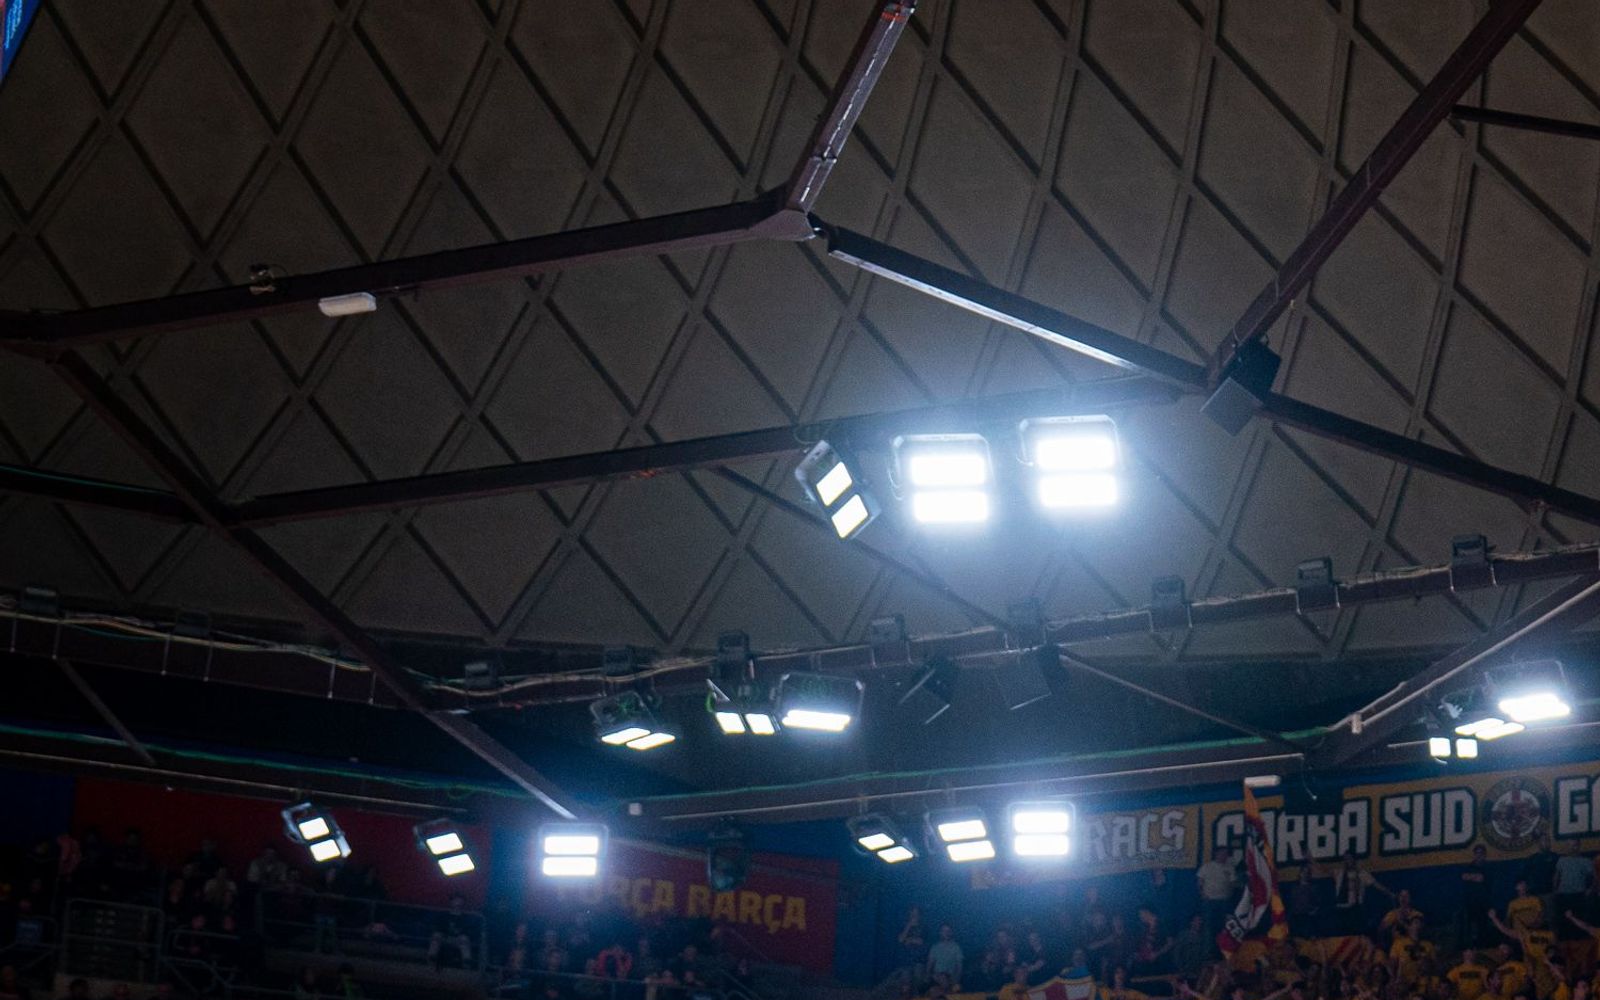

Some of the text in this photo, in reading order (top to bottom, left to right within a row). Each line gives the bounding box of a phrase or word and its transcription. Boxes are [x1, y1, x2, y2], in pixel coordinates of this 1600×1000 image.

[1084, 809, 1186, 858] RACS
[1382, 788, 1475, 851] SUD
[687, 884, 807, 935] BARÇA
